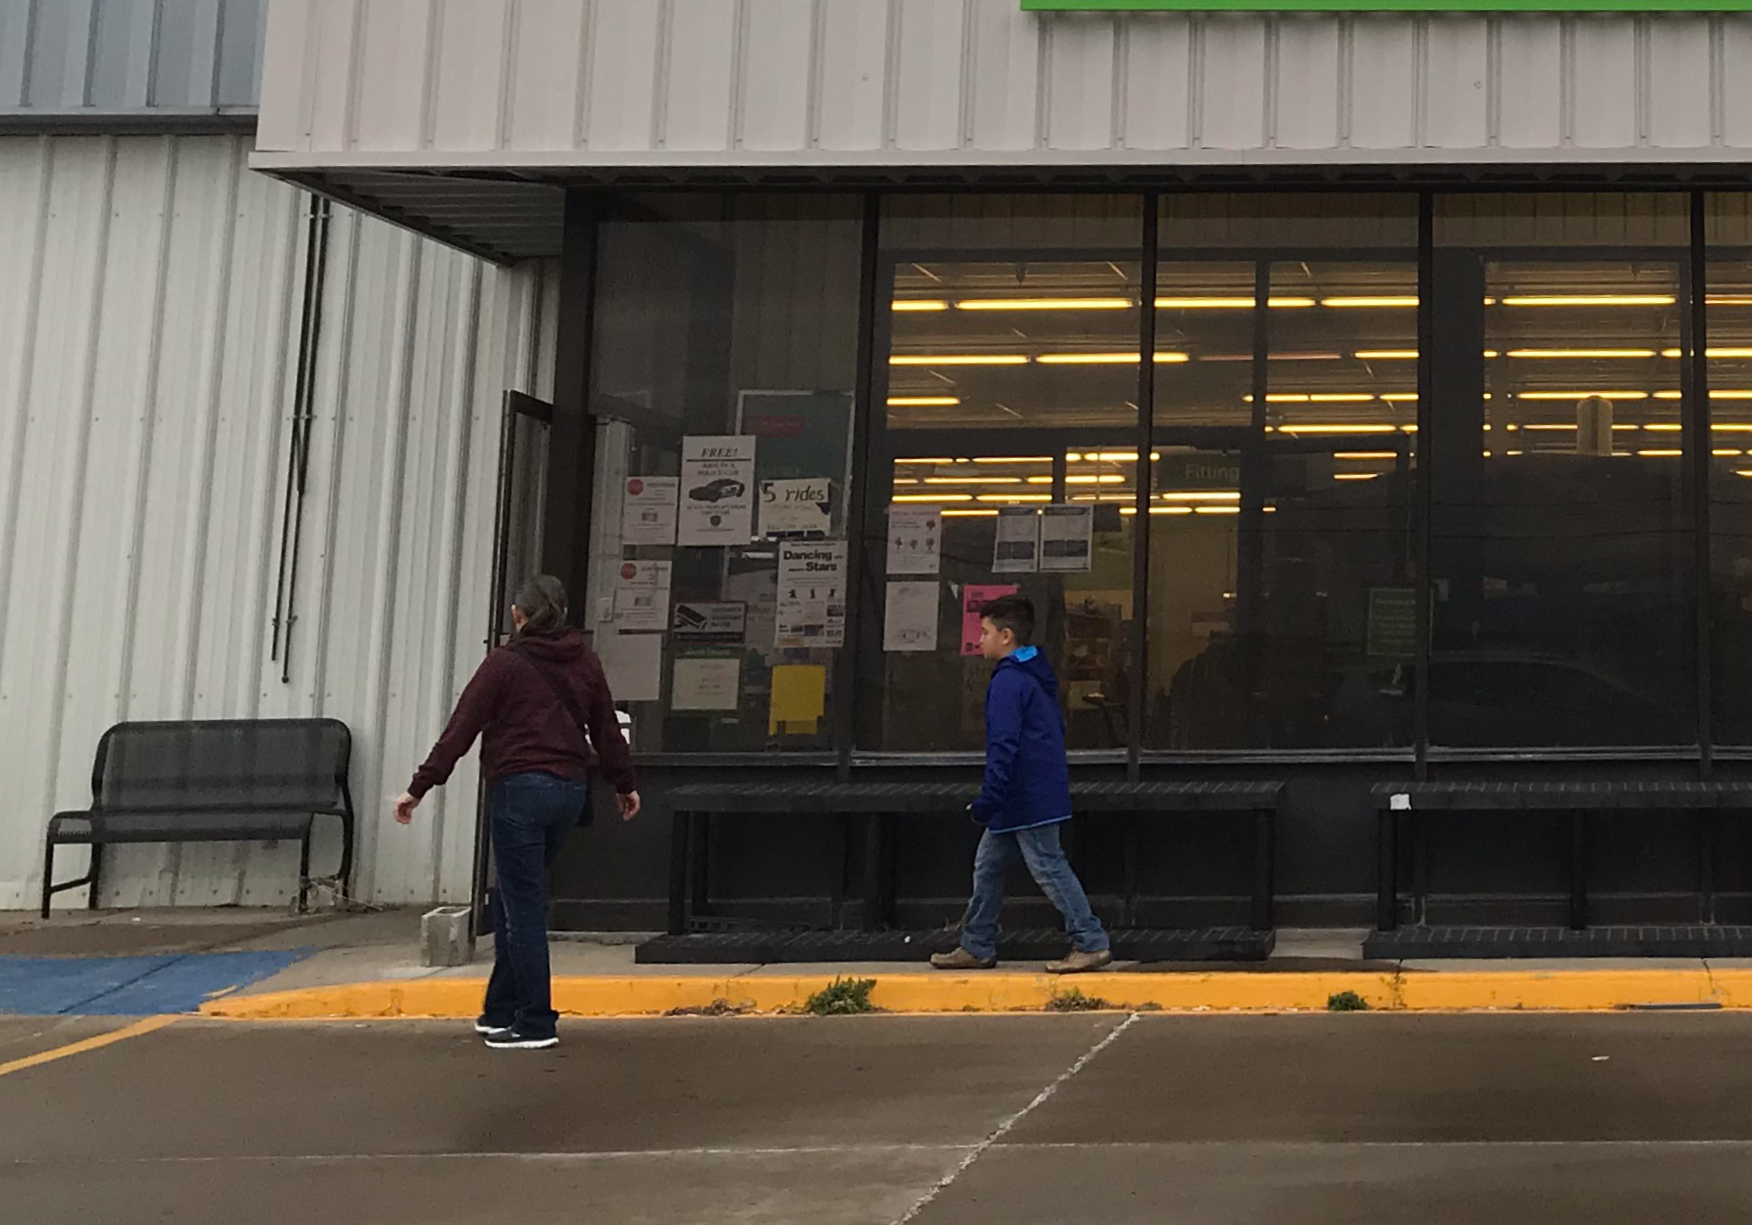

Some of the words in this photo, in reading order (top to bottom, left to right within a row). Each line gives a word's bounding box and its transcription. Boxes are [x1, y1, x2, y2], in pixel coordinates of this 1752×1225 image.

[701, 447, 739, 458] FREE!
[1184, 463, 1240, 483] Fitting
[762, 482, 777, 503] 5
[785, 485, 825, 502] rides
[783, 550, 833, 561] Dancing
[806, 561, 838, 572] Stars
